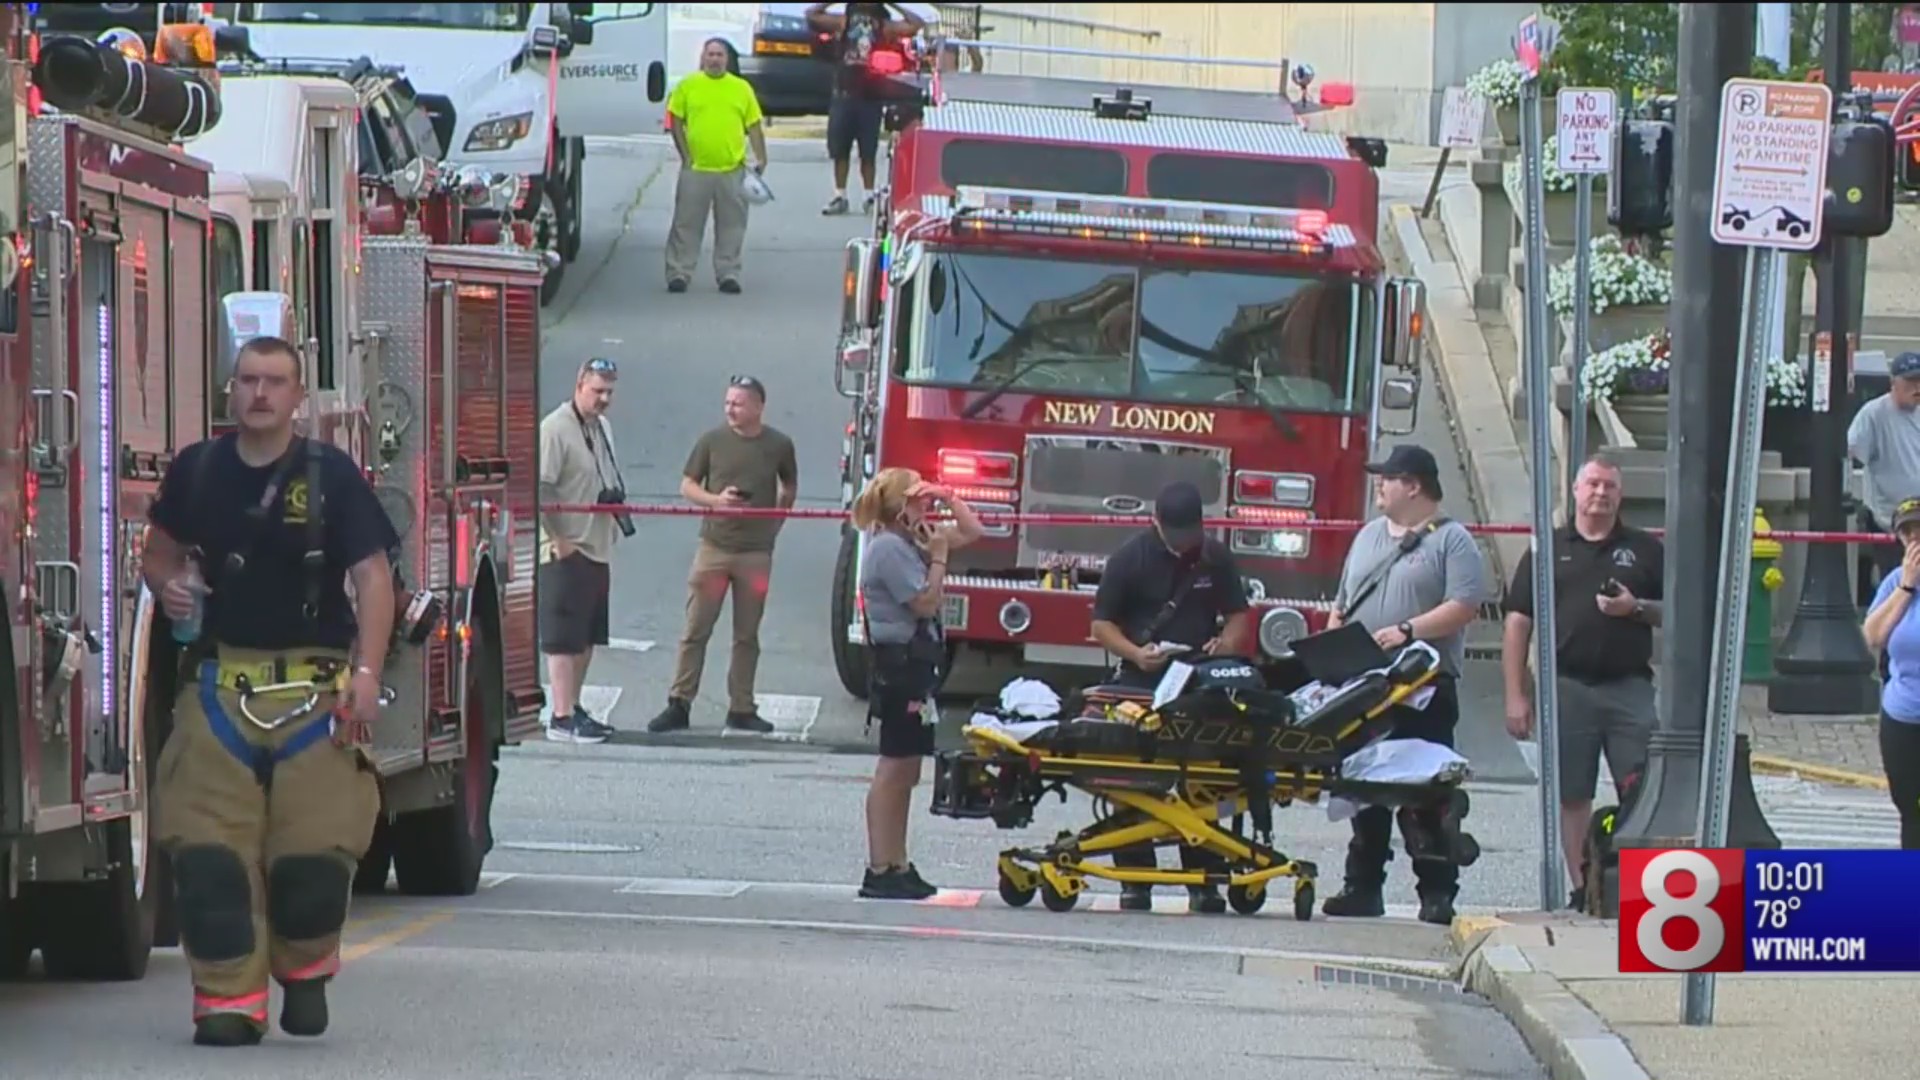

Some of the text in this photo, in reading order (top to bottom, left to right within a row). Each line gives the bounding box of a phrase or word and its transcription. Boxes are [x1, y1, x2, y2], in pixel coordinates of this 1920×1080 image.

[560, 64, 638, 79] EVERSOURCE
[1575, 96, 1597, 112] NO
[1562, 114, 1609, 130] PARKING
[1736, 120, 1817, 136] NO PARKING
[1575, 132, 1596, 141] ANY
[1731, 133, 1819, 150] NO STANDING
[1574, 143, 1597, 154] TIME
[1735, 148, 1812, 164] AT ANYTIME
[1044, 401, 1216, 434] NEW LONDON
